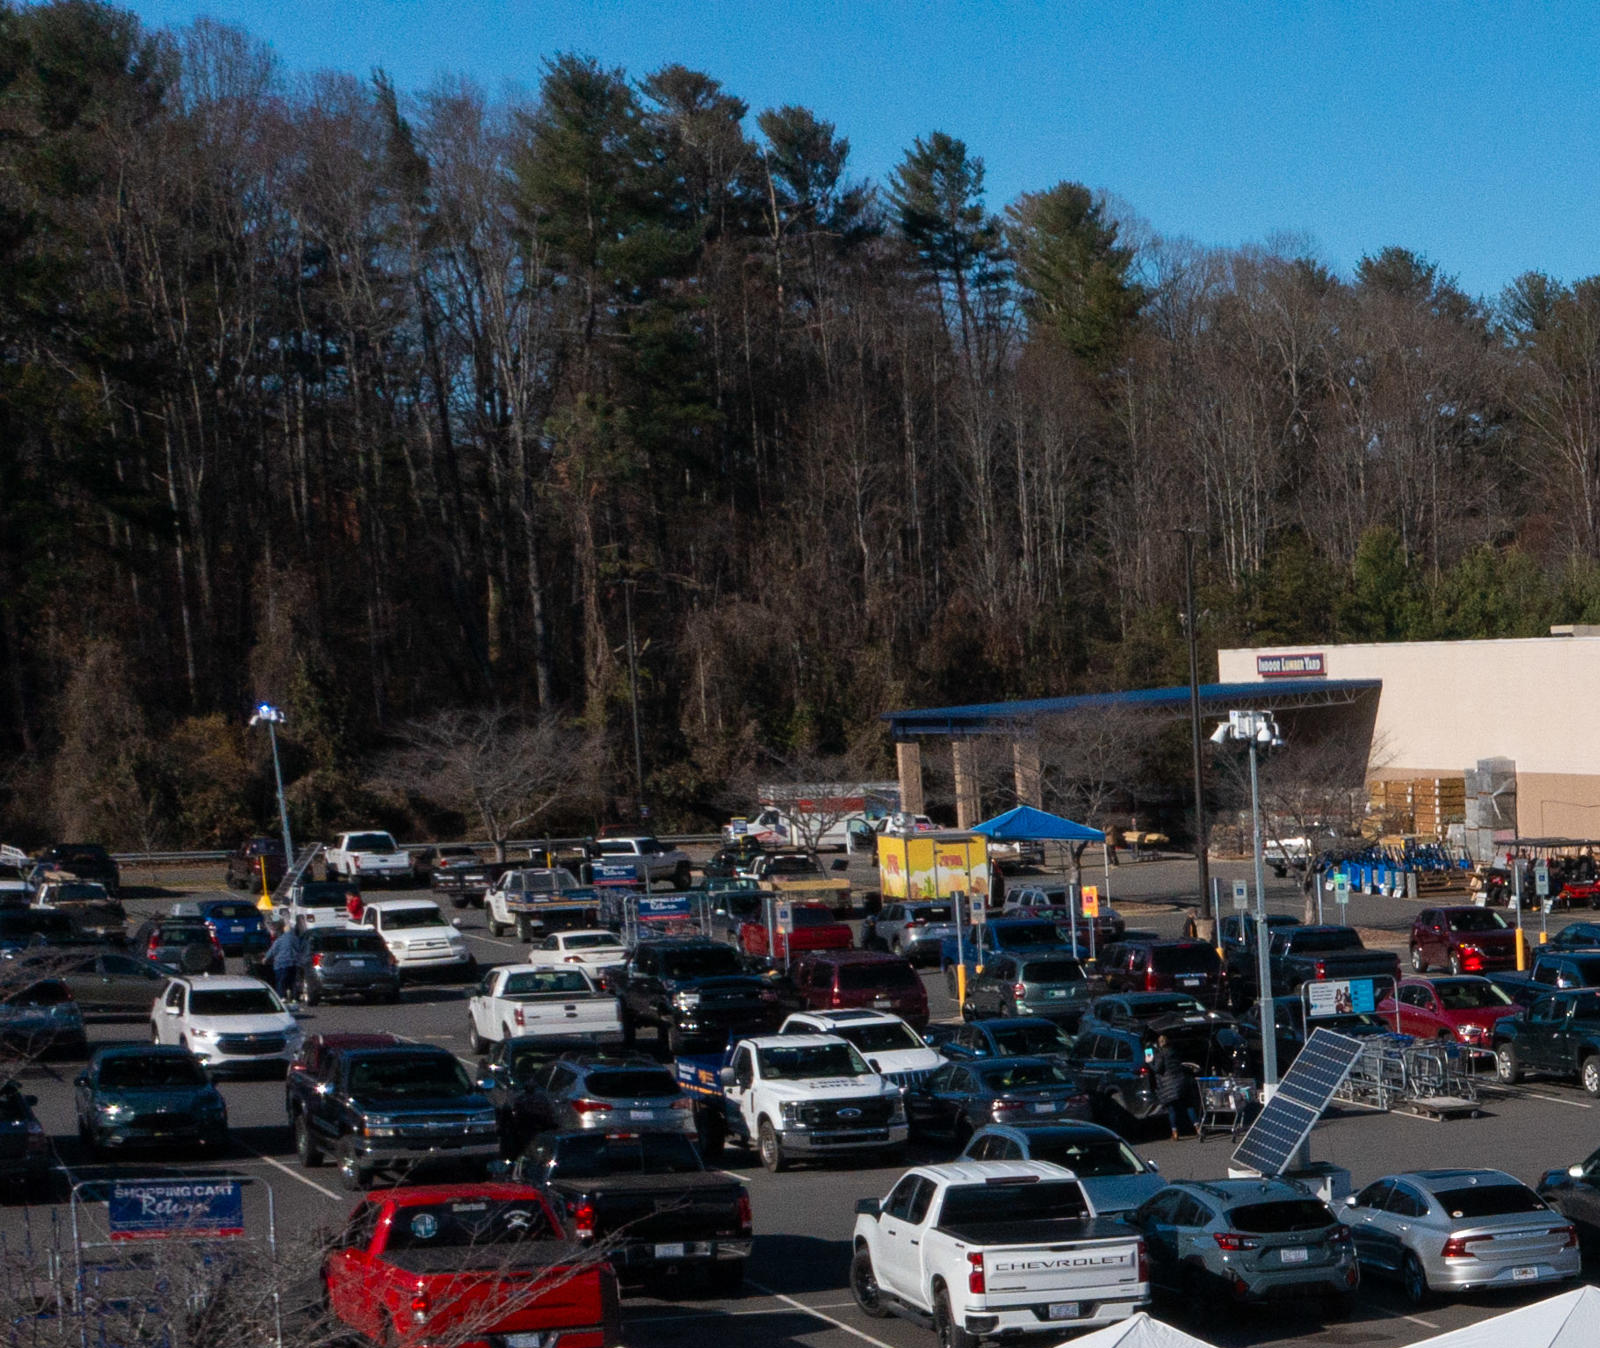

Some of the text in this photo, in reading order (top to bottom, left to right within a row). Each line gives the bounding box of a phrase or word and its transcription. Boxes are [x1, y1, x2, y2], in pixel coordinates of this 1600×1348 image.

[1282, 657, 1304, 671] LUMBER
[1304, 656, 1321, 670] YARD
[114, 1185, 234, 1199] SHOPPING CART
[995, 1254, 1129, 1271] CHEVROLET
